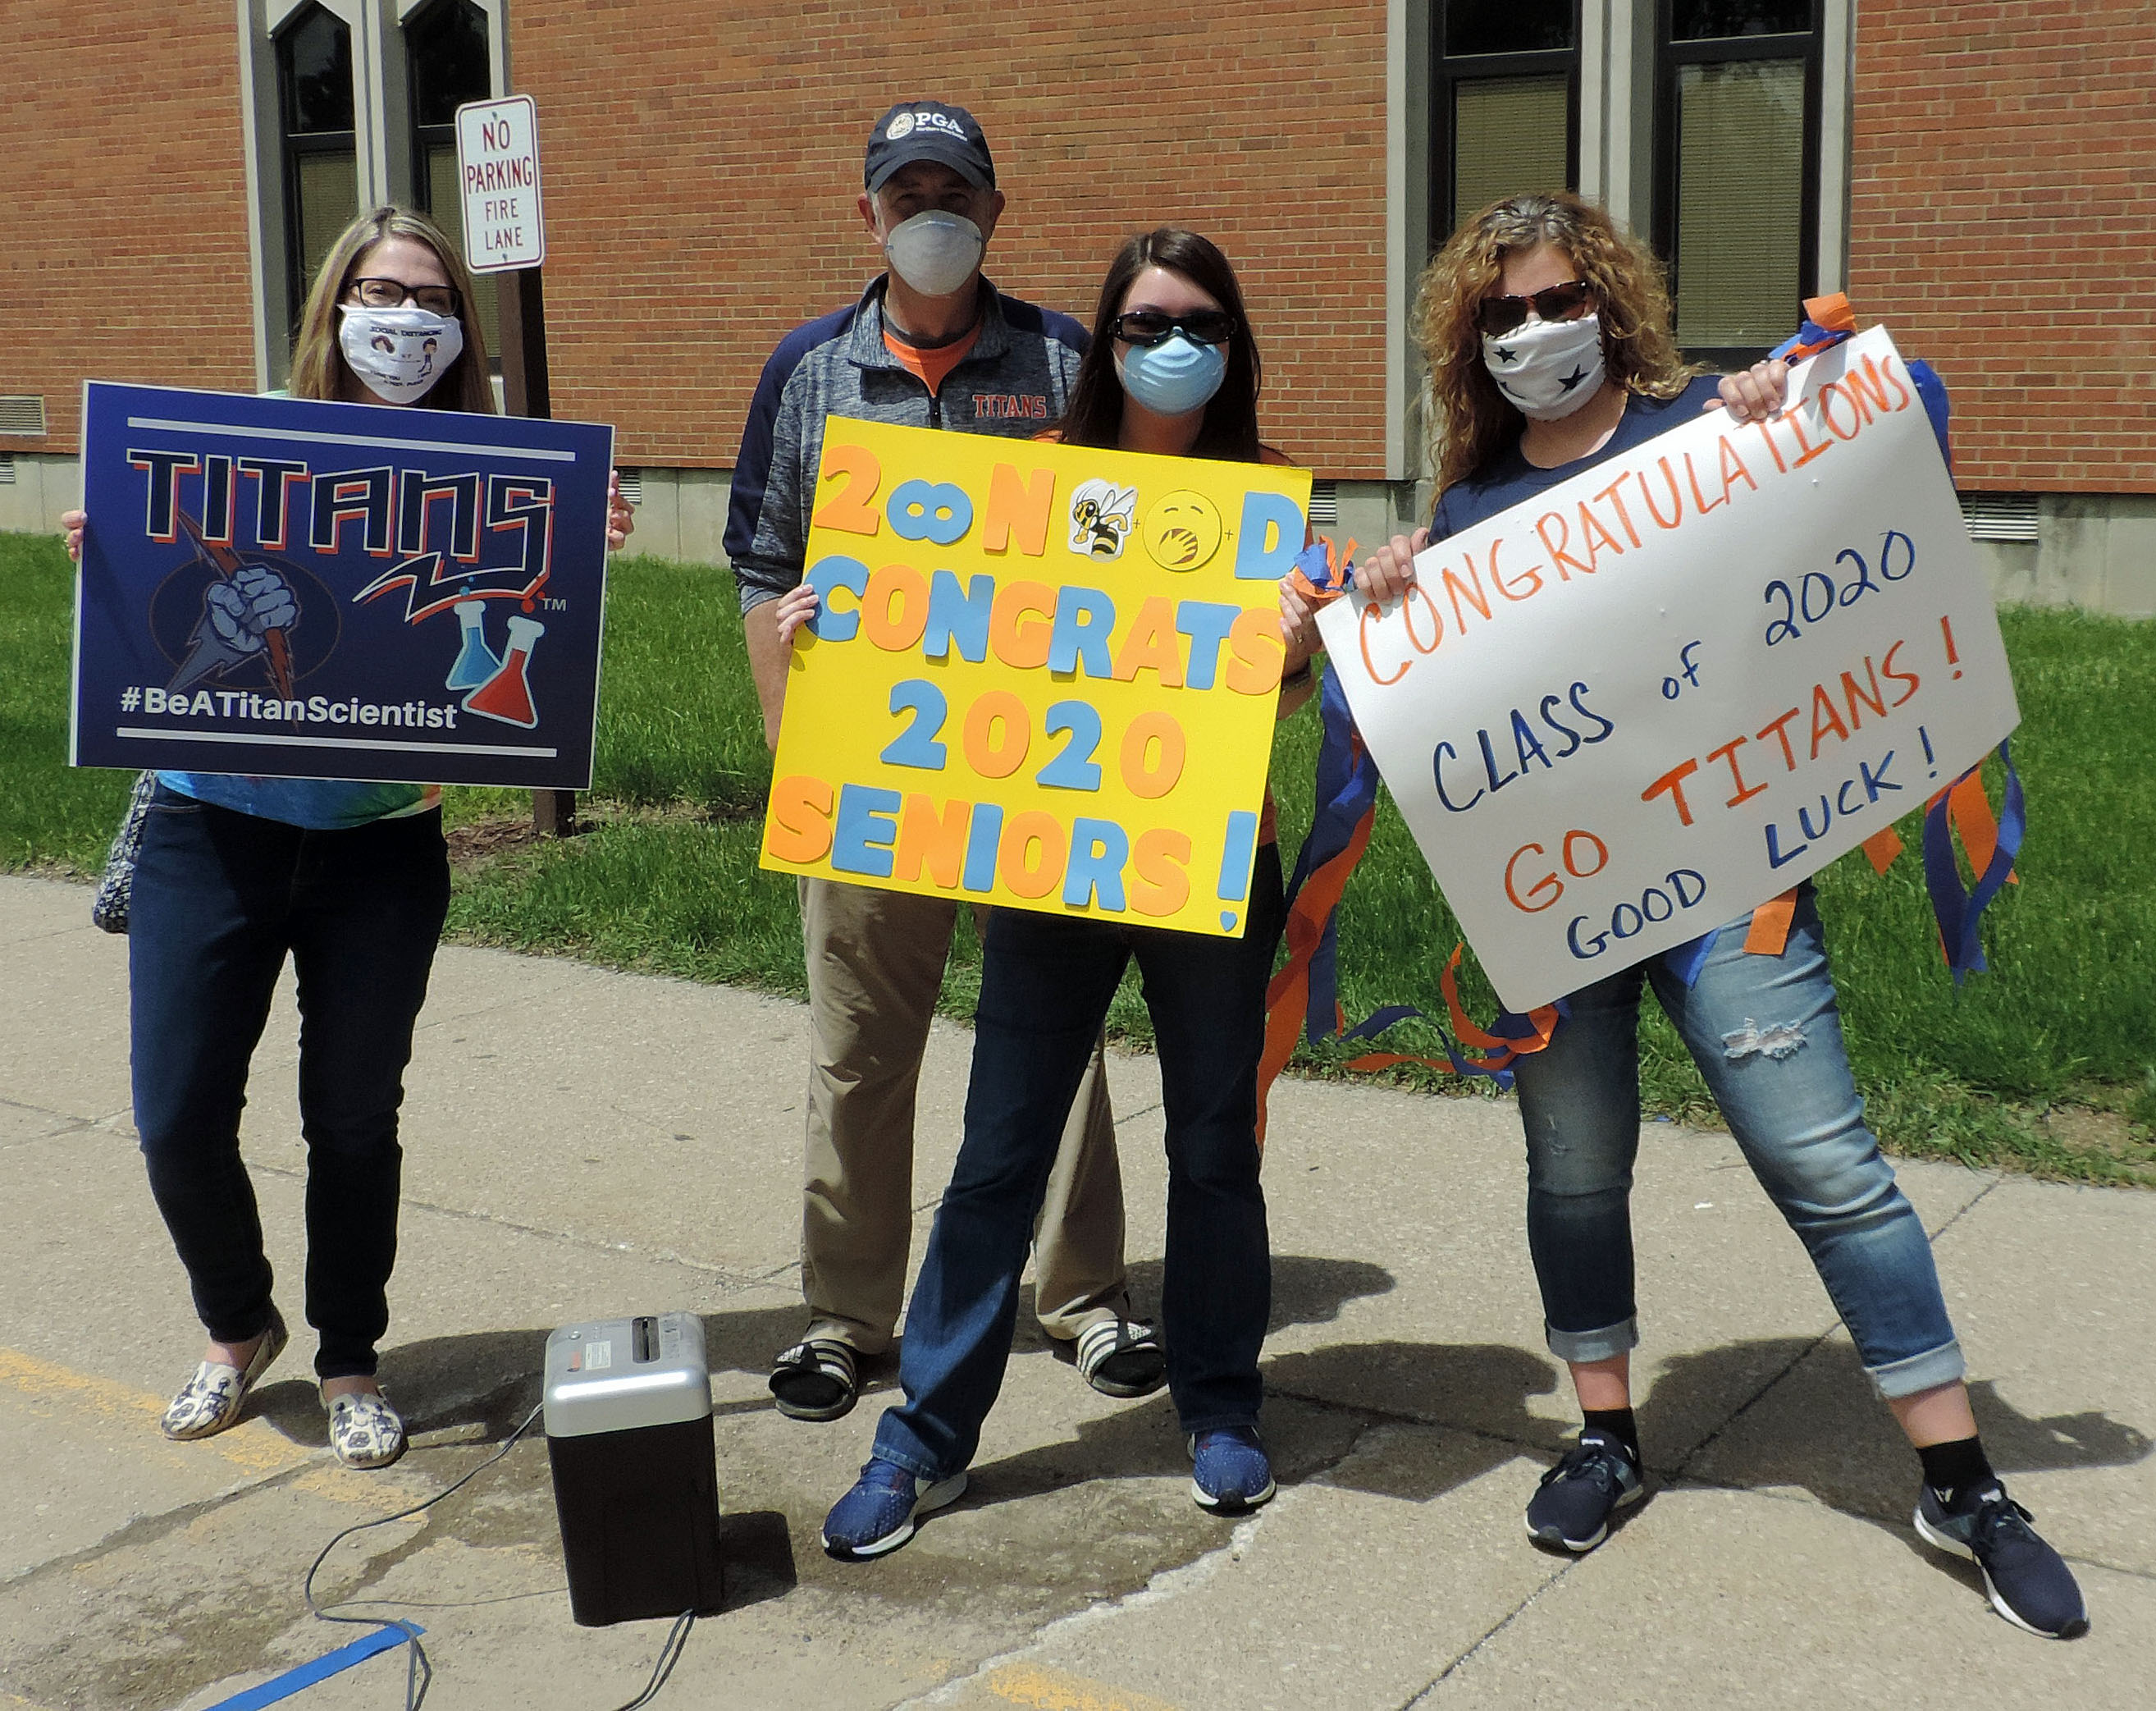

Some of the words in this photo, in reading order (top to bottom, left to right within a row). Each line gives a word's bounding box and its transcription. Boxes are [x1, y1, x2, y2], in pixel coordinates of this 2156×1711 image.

[482, 120, 510, 152] NO
[915, 112, 964, 135] PGA
[467, 156, 532, 194] PARKING
[485, 198, 519, 222] FIRE
[485, 226, 523, 251] LANE
[971, 394, 1047, 419] TITANS
[126, 448, 556, 615] TITANS
[1359, 352, 1912, 686] CONGRATULATIONS
[804, 555, 1288, 696] CONGRATS
[1432, 680, 1615, 814] CLASS
[1660, 640, 1704, 702] of
[1764, 529, 1916, 648] 2020
[121, 686, 459, 730] #BeATitanScientist
[879, 679, 1186, 800] 2020
[1504, 829, 1610, 914] GO
[1566, 868, 1708, 960] GOOD
